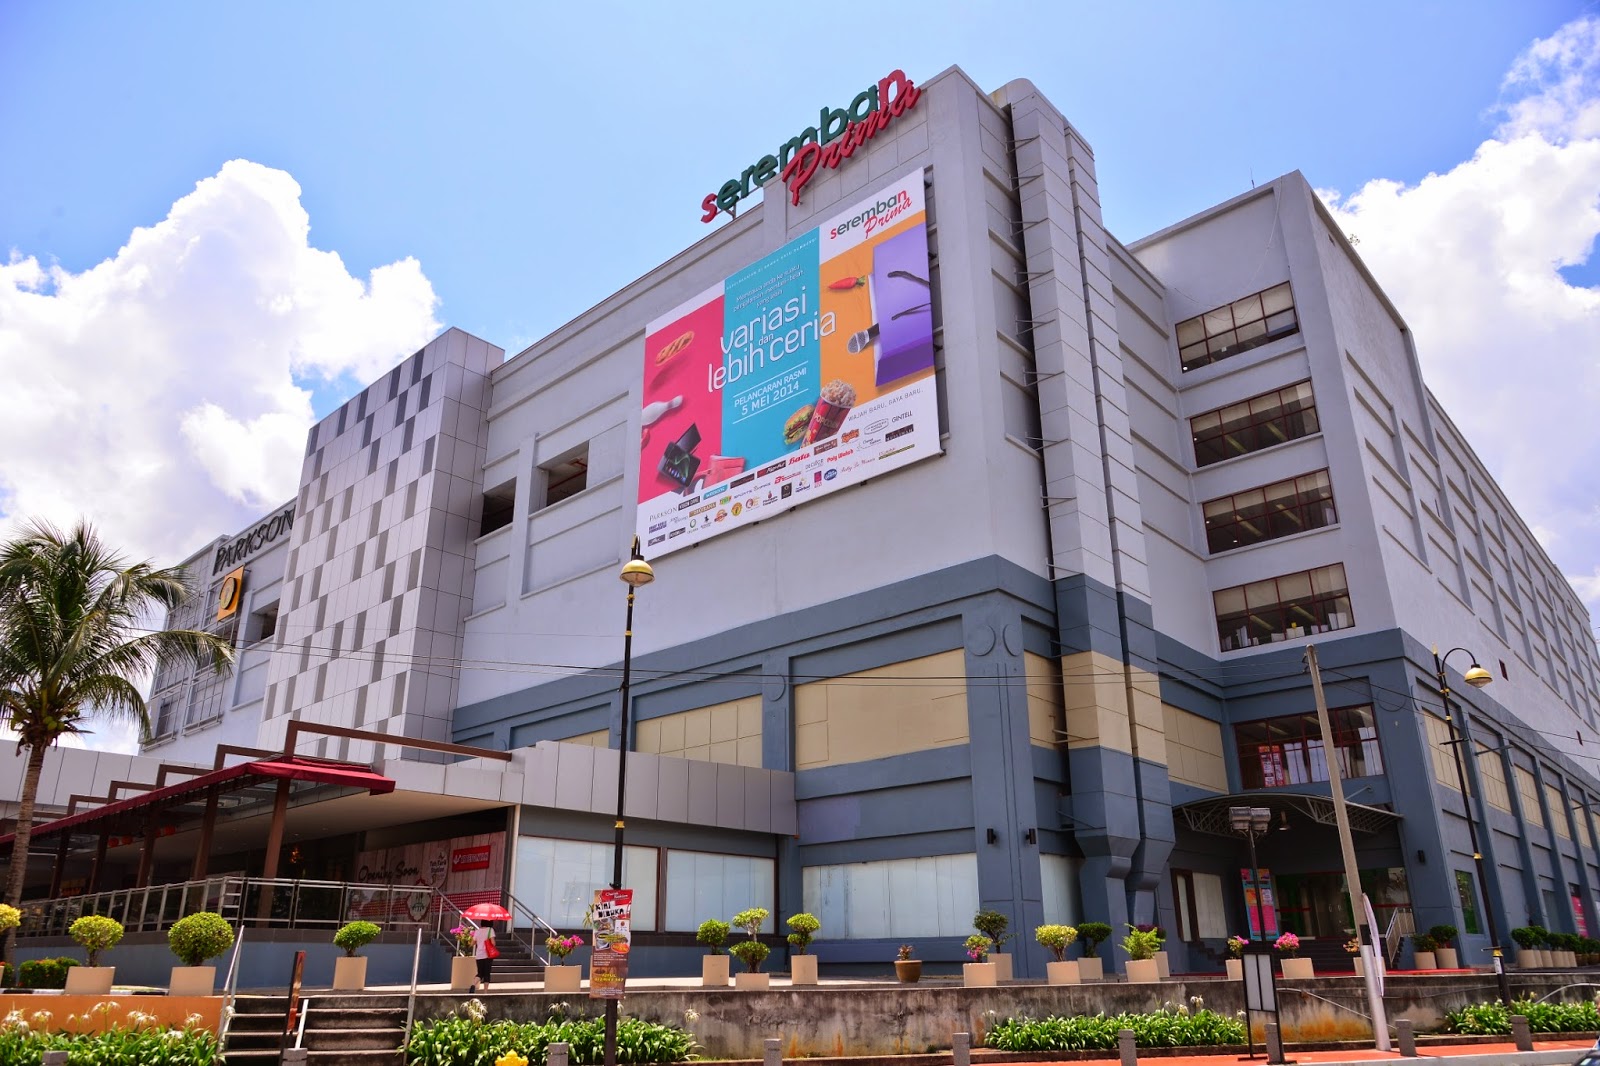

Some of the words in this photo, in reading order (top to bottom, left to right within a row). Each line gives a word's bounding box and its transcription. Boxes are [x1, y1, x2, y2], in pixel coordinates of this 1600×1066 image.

[700, 69, 906, 223] seremban
[782, 79, 921, 206] Prima
[830, 190, 907, 240] seremban
[864, 196, 912, 239] Prima
[720, 286, 806, 354] variasi
[758, 332, 774, 346] dan
[708, 341, 764, 393] lebih
[769, 311, 836, 362] ceria
[734, 379, 783, 408] PELANCARAN
[783, 367, 807, 385] RASMI
[741, 405, 749, 416] 5
[751, 394, 771, 412] MEI
[773, 380, 800, 401] 2014
[848, 409, 868, 421] WAJAH
[869, 402, 887, 414] BARU.
[888, 395, 903, 406] GAYA
[904, 388, 924, 399] BARU.
[891, 410, 913, 423] GINTELL
[788, 453, 811, 465] Bata
[649, 506, 678, 522] PARKSON
[212, 505, 296, 576] PARKSON
[358, 865, 394, 882] Opening
[394, 861, 419, 878] Soon
